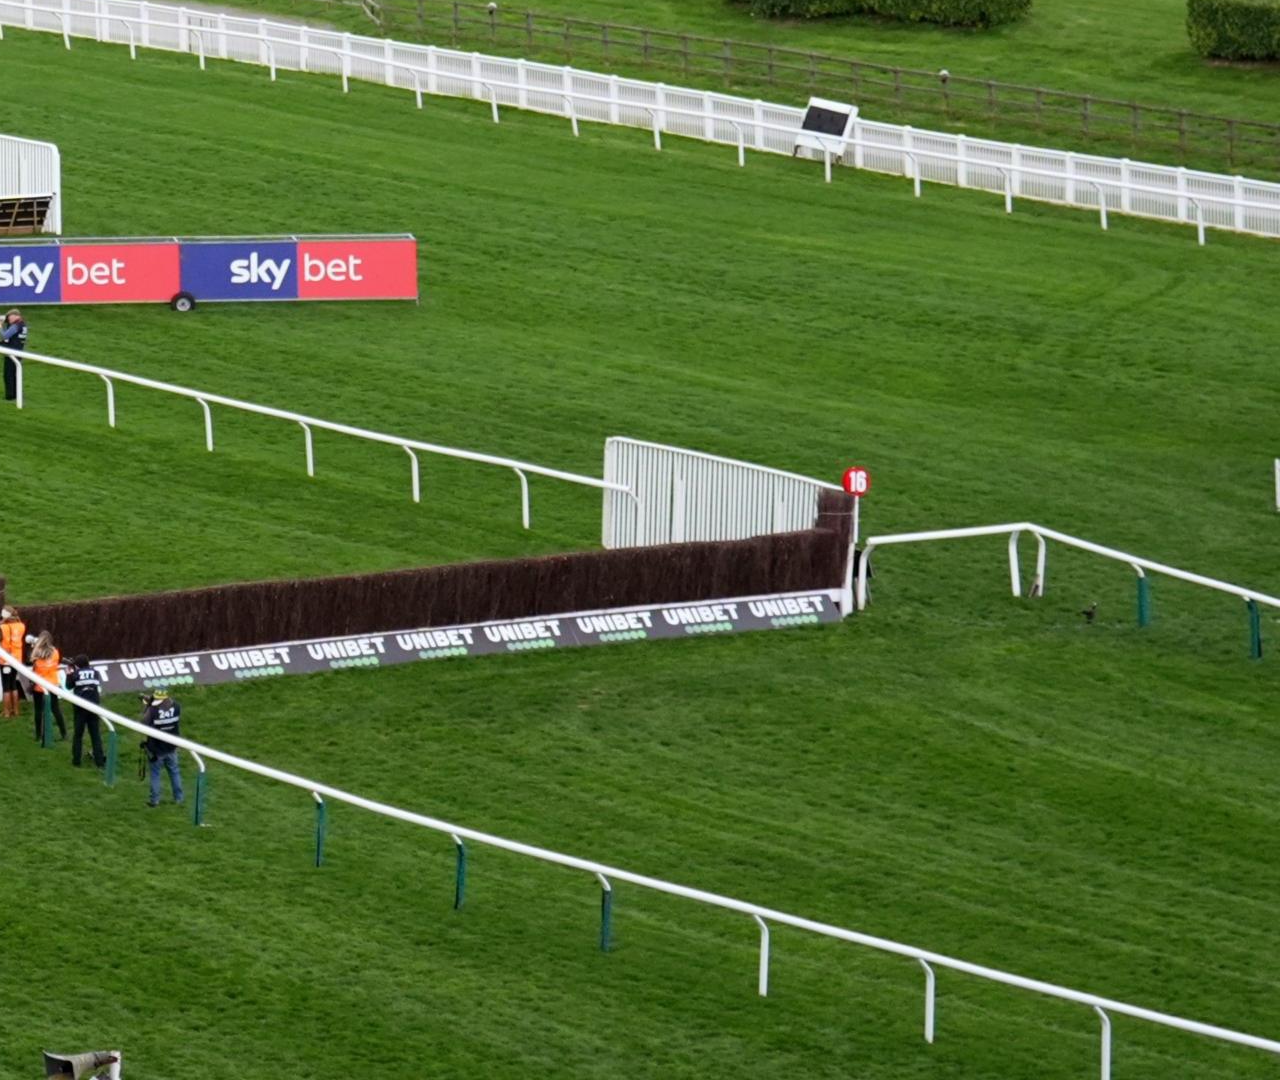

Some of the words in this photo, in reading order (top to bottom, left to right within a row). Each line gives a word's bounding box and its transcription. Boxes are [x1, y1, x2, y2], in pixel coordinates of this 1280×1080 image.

[67, 257, 126, 285] bet
[230, 252, 291, 290] sky
[304, 253, 363, 282] bet
[849, 470, 867, 492] 16
[120, 655, 201, 680] UNIBET
[211, 646, 292, 672] UNIBET
[306, 636, 385, 663] UNIBET
[396, 628, 475, 651] UNIBET
[483, 619, 562, 643] UNIBET
[576, 611, 654, 635] UNIBET
[662, 603, 740, 626] UNIBET
[748, 595, 825, 619] UNIBET
[78, 670, 95, 680] 277
[158, 707, 175, 719] 247
